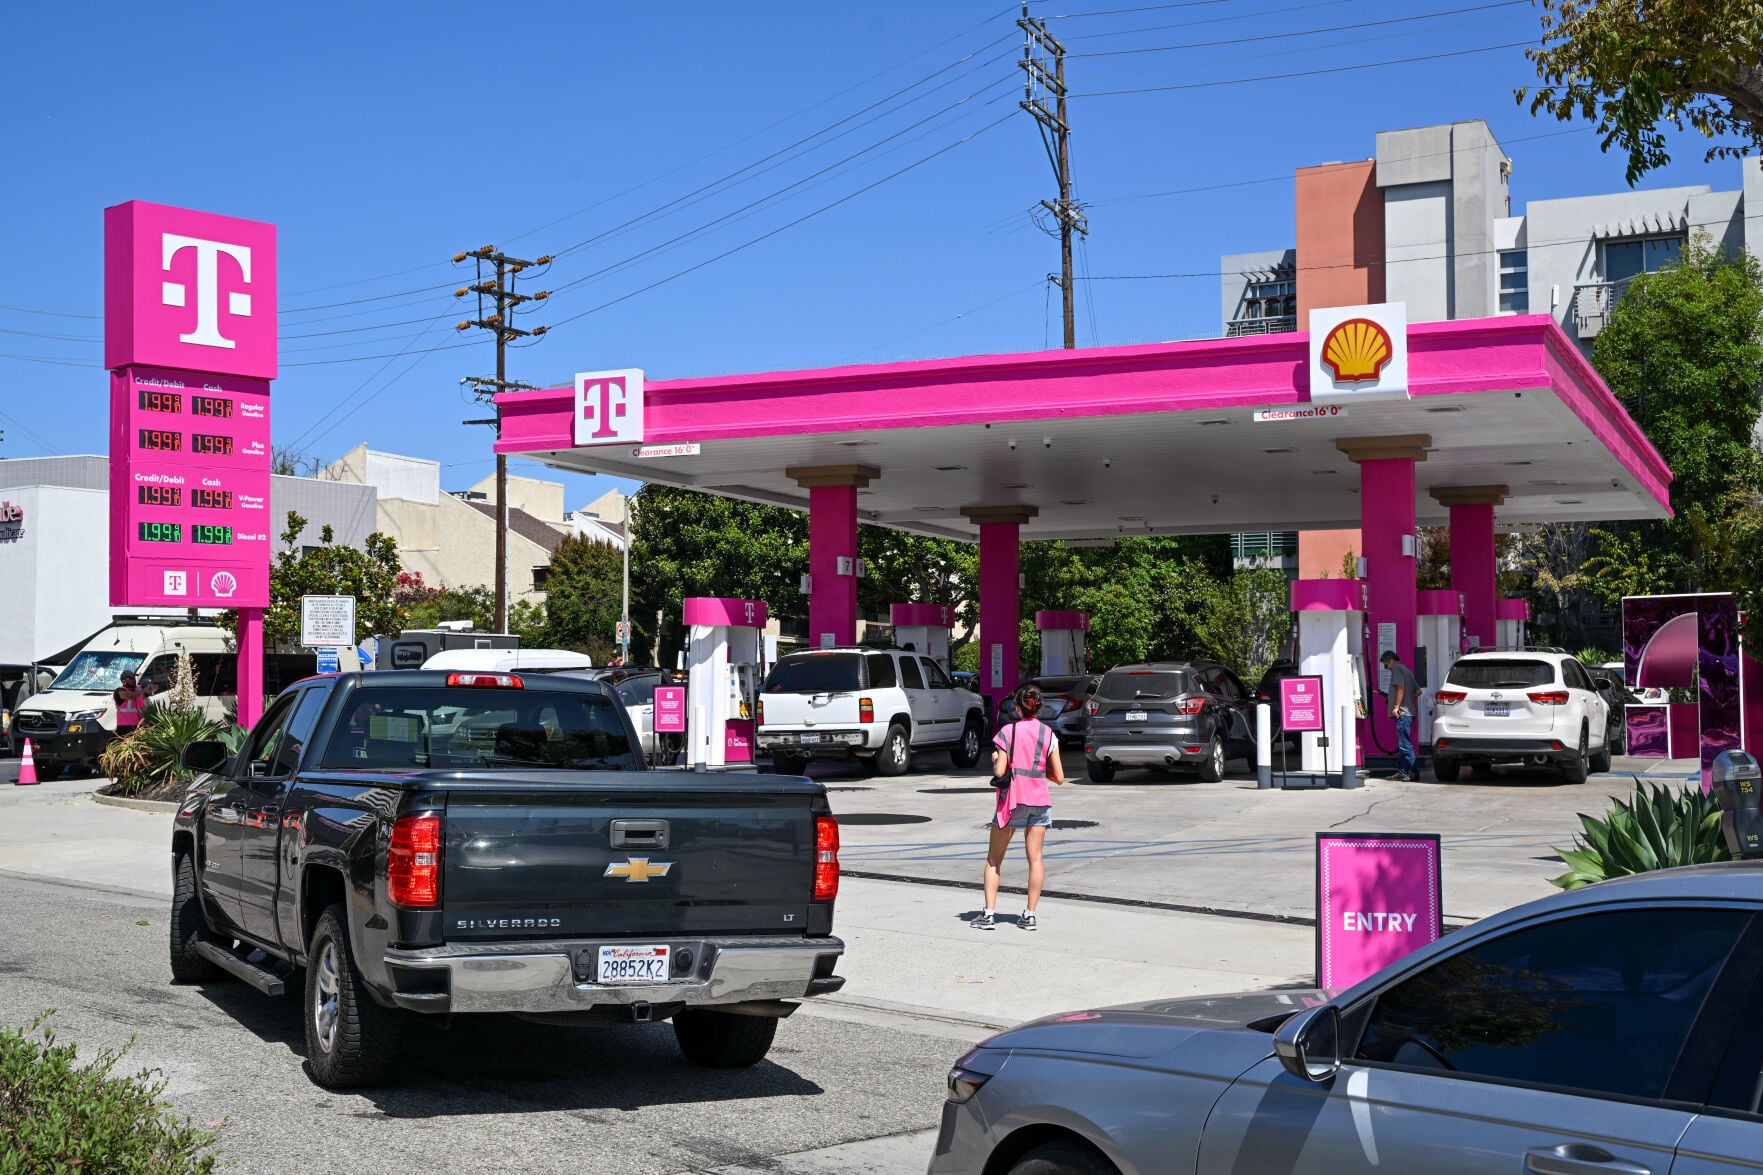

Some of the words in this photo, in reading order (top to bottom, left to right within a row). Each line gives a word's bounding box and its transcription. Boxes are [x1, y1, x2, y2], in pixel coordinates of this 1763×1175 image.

[162, 232, 252, 349] T
[135, 377, 185, 389] Credit/Debit
[203, 384, 222, 393] Cash
[240, 402, 264, 411] Regular
[583, 375, 626, 438] T
[241, 410, 264, 418] Gasoline
[252, 441, 265, 449] Plus
[632, 447, 673, 457] Clearance
[135, 473, 185, 484] Credit/Debit
[202, 477, 221, 486] Cash
[238, 495, 264, 503] V-Power
[237, 533, 257, 541] Diesel
[257, 533, 267, 541] #2
[745, 602, 755, 624] T
[783, 914, 795, 922] LT
[1343, 911, 1418, 932] ENTRY
[457, 918, 560, 929] SILVERADO
[612, 948, 656, 960] California
[602, 959, 664, 979] 28852K2
